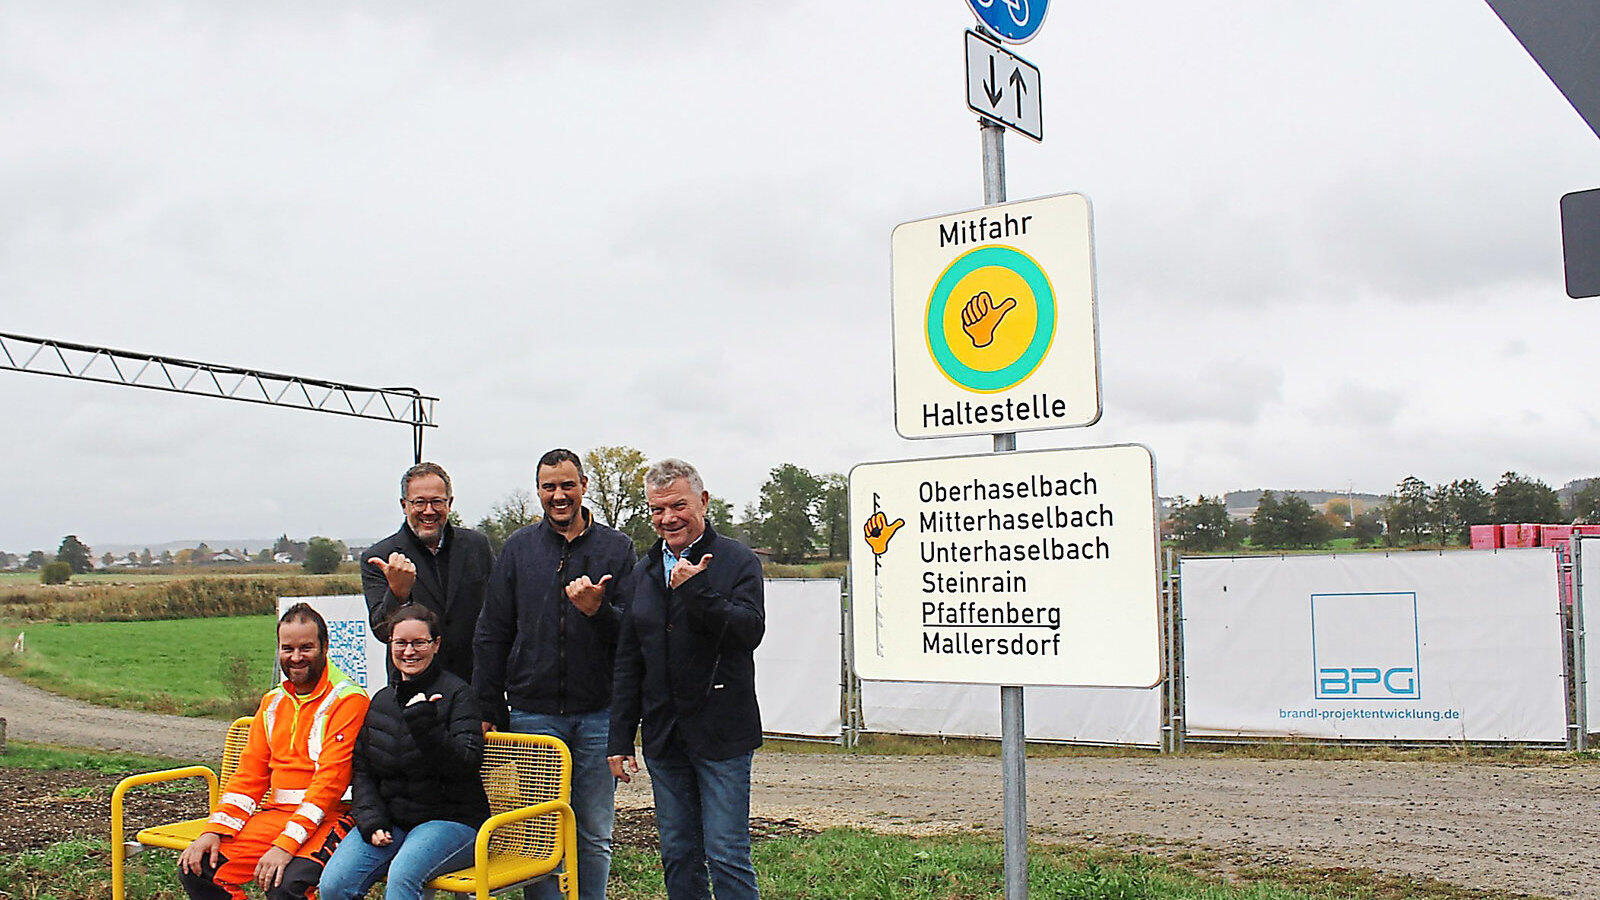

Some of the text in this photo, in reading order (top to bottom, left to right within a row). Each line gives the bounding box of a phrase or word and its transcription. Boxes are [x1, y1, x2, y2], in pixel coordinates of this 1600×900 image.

[939, 213, 1033, 248] Mitfahr
[922, 393, 1067, 428] Haltestelle
[919, 472, 1098, 503] Oberhaselbach
[919, 504, 1114, 533] Mitterhaselbach
[920, 536, 1110, 563] Unterhaselbach
[922, 570, 1027, 593] Steinrain
[922, 602, 1061, 630] Pfaffenberg
[923, 632, 1061, 656] Mallersdorf
[1320, 667, 1414, 694] BPG
[1279, 708, 1460, 722] brandl-projektentwicklung.de
